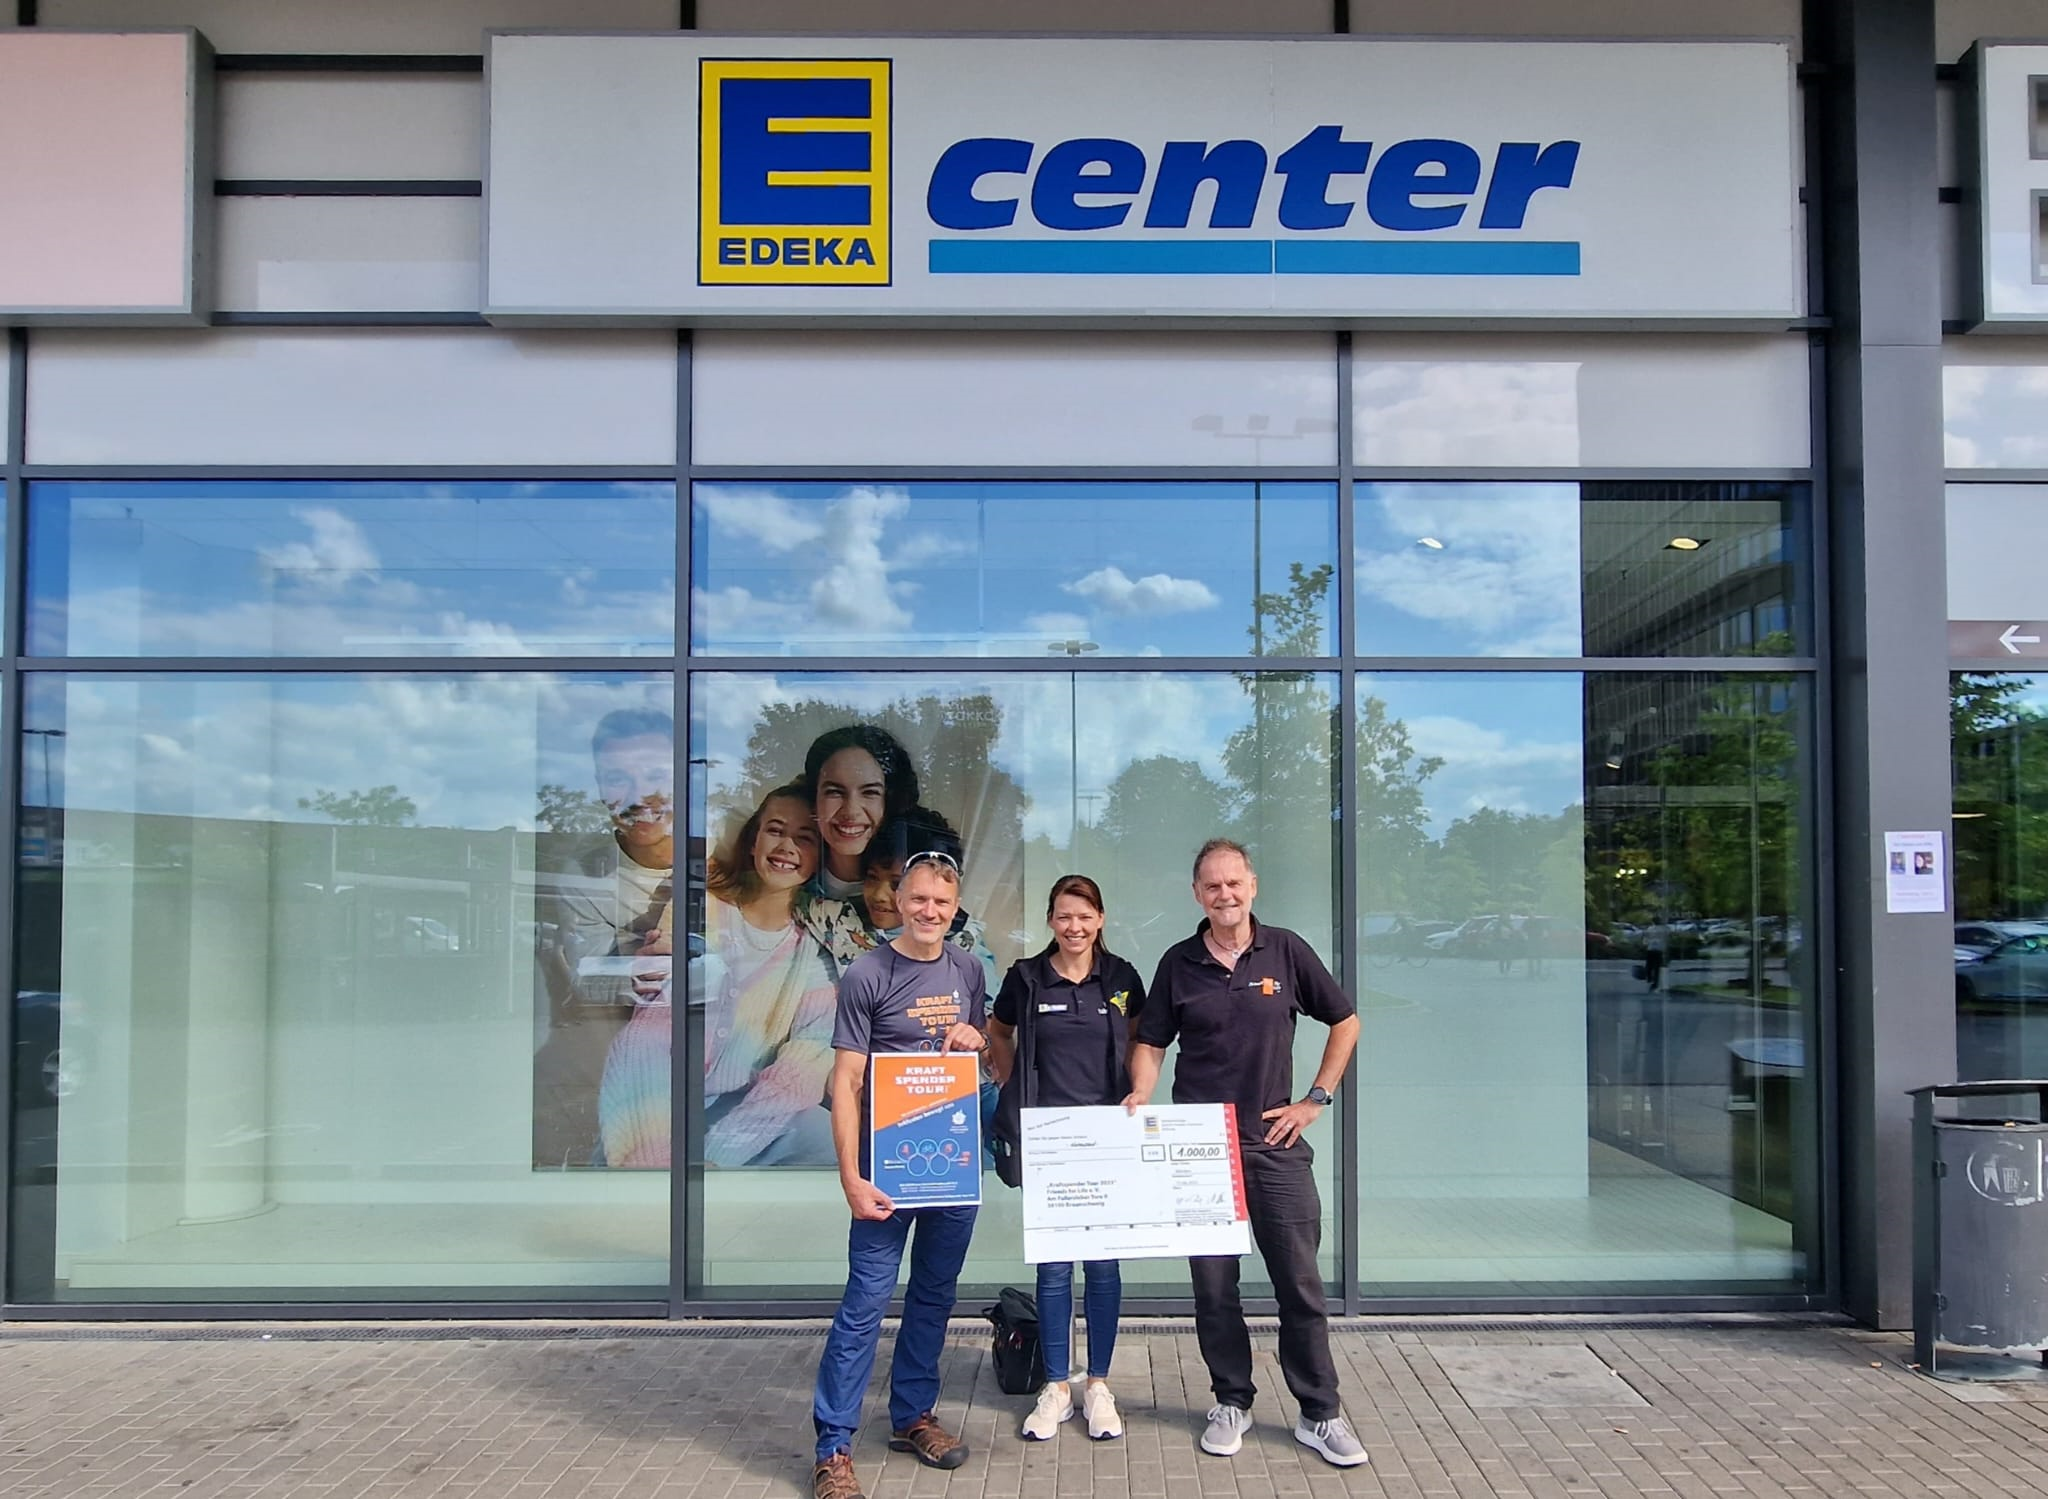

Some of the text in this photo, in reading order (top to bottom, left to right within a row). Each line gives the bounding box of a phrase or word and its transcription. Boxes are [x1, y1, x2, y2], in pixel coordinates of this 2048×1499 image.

[927, 125, 1581, 232] center
[718, 238, 876, 266] EDEKA
[905, 1066, 946, 1075] KRAFT
[895, 1075, 956, 1085] SPENDER
[1176, 1146, 1221, 1159] 1.000,00
